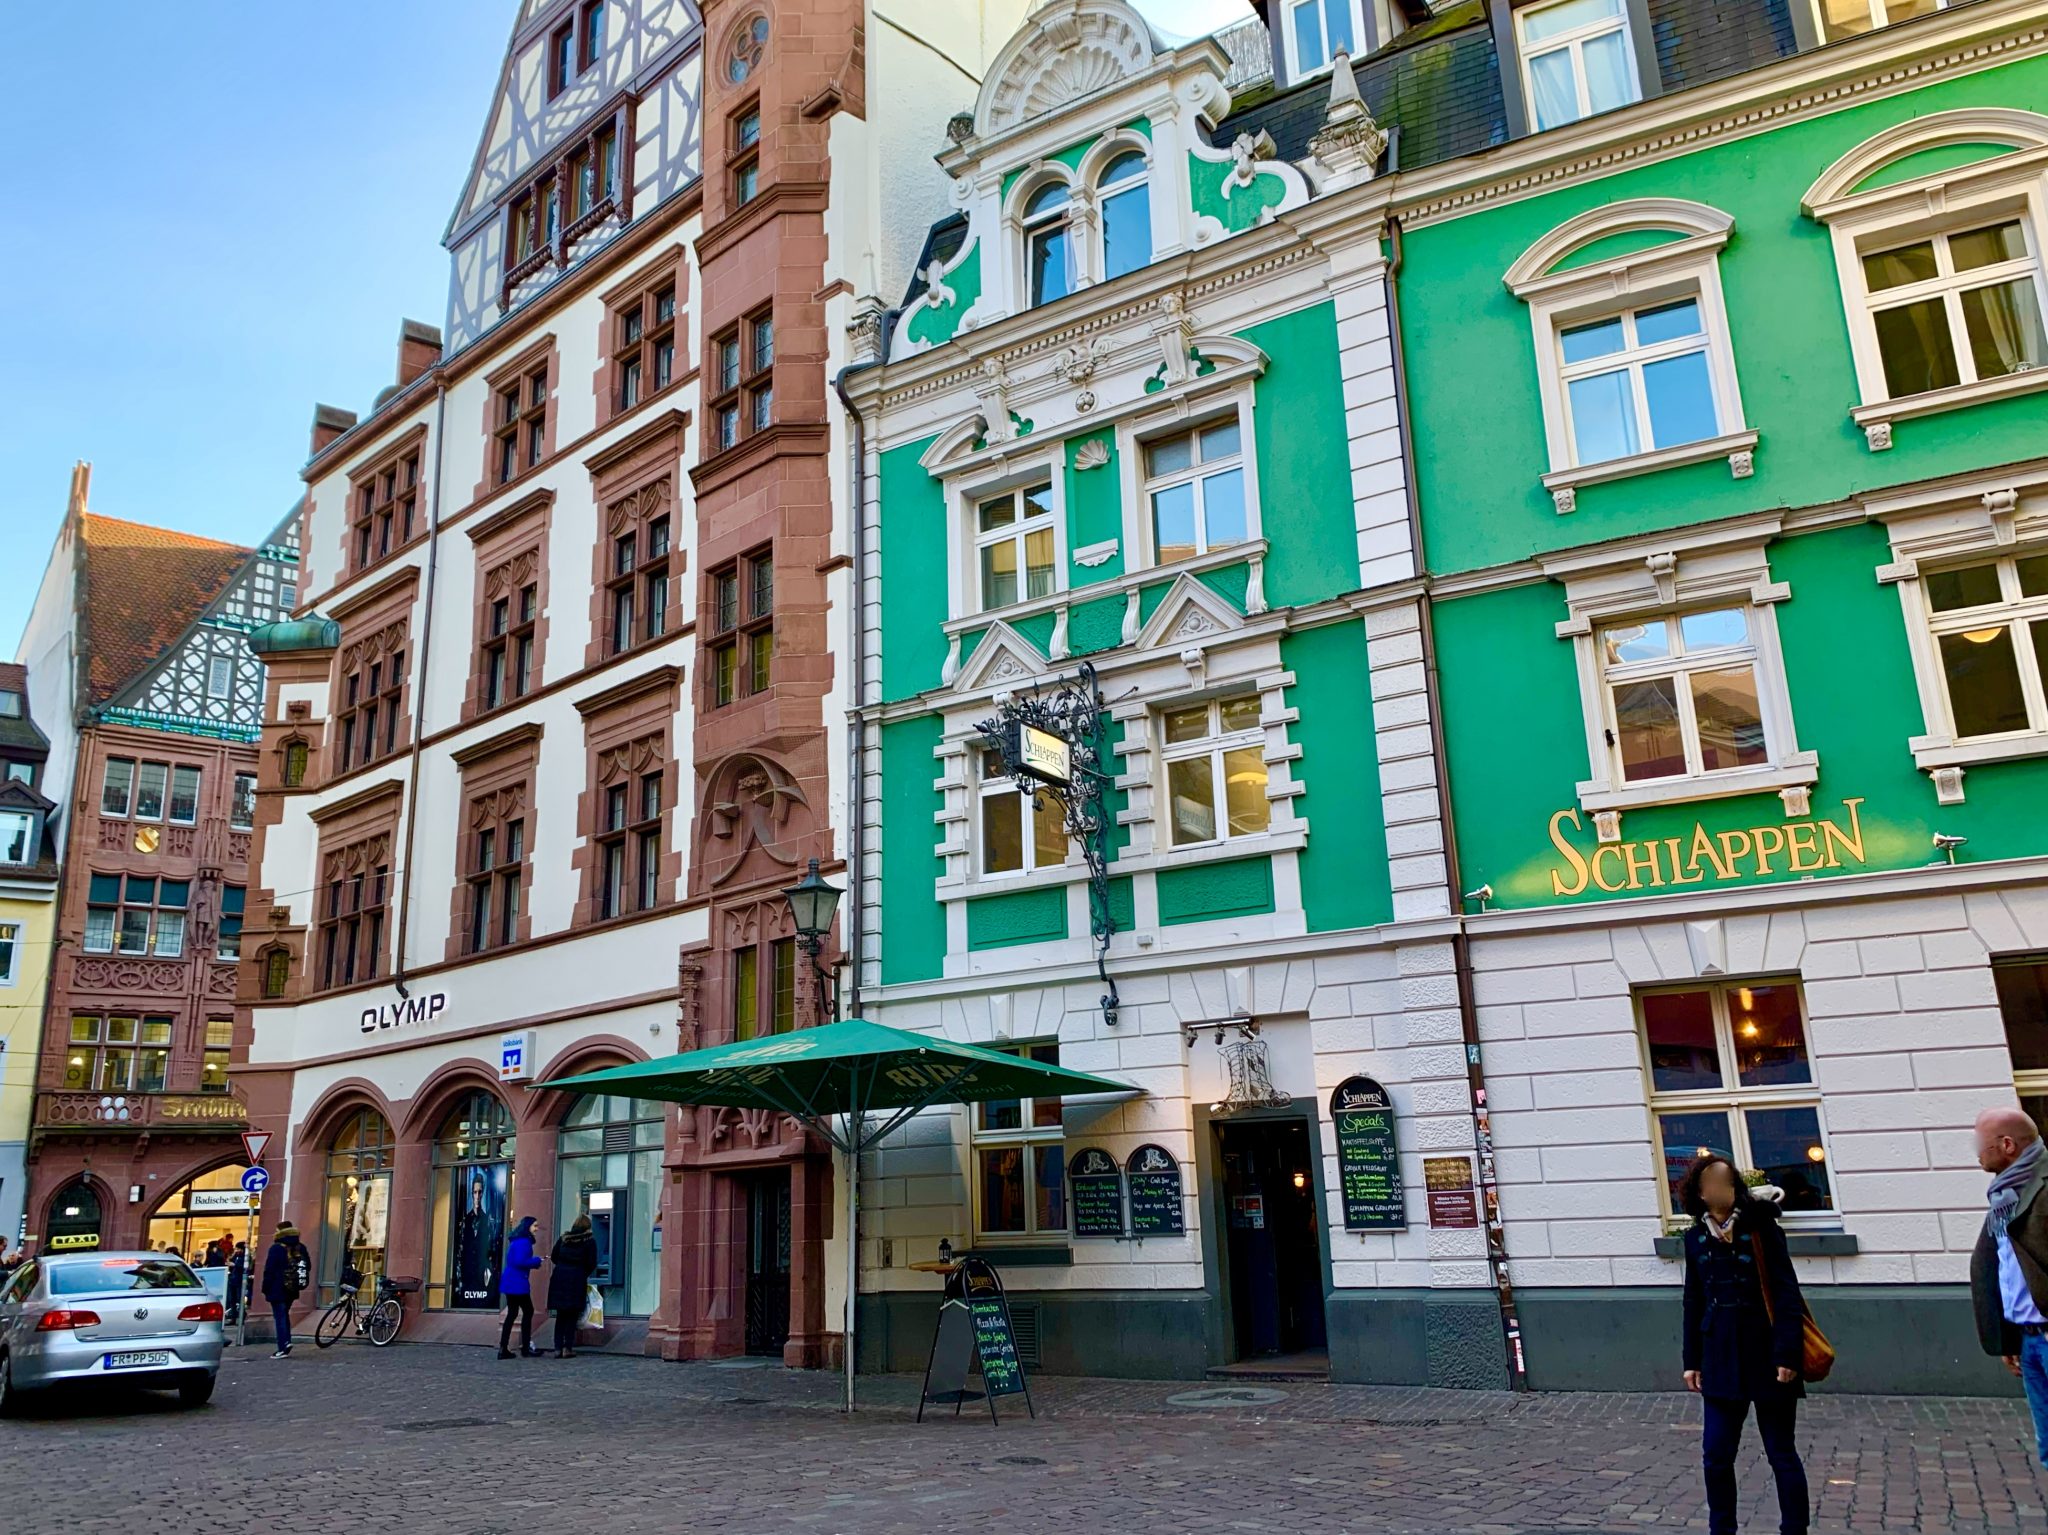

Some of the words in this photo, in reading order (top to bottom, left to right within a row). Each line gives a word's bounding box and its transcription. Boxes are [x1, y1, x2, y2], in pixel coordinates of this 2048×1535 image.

[1025, 728, 1065, 767] SCHLAPPEN
[1548, 797, 1865, 896] SCHLAPPEN
[361, 993, 445, 1033] OLYMP
[503, 1038, 523, 1047] Volksbank
[1342, 1088, 1383, 1104] SCHLAPPEN
[1343, 1113, 1385, 1133] Specials
[194, 1195, 229, 1205] Badische
[60, 1235, 92, 1244] TAXI
[464, 1290, 488, 1299] OLYMP
[111, 1354, 126, 1364] FR
[133, 1352, 146, 1362] PP
[148, 1350, 168, 1362] 505
